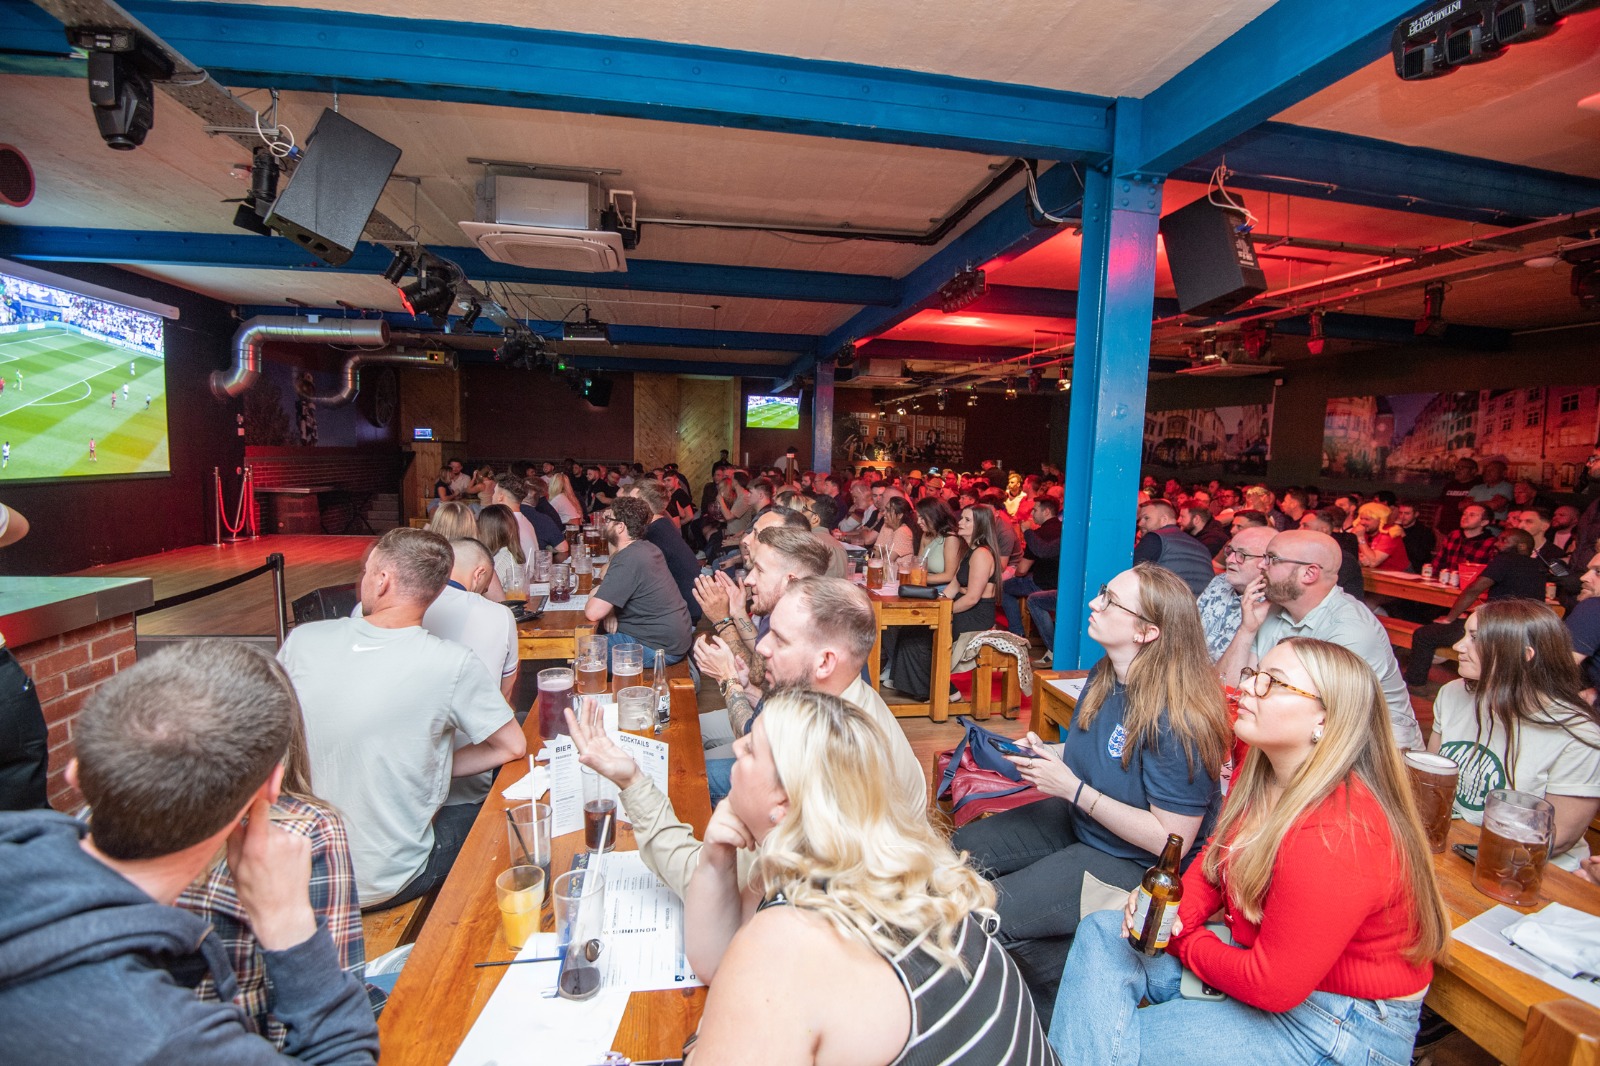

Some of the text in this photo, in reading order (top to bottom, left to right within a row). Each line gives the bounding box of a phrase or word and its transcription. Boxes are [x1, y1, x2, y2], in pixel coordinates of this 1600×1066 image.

[1408, 1, 1462, 36] INTIMIDATOR
[620, 735, 650, 748] COCKTAILS
[555, 744, 572, 753] BIER
